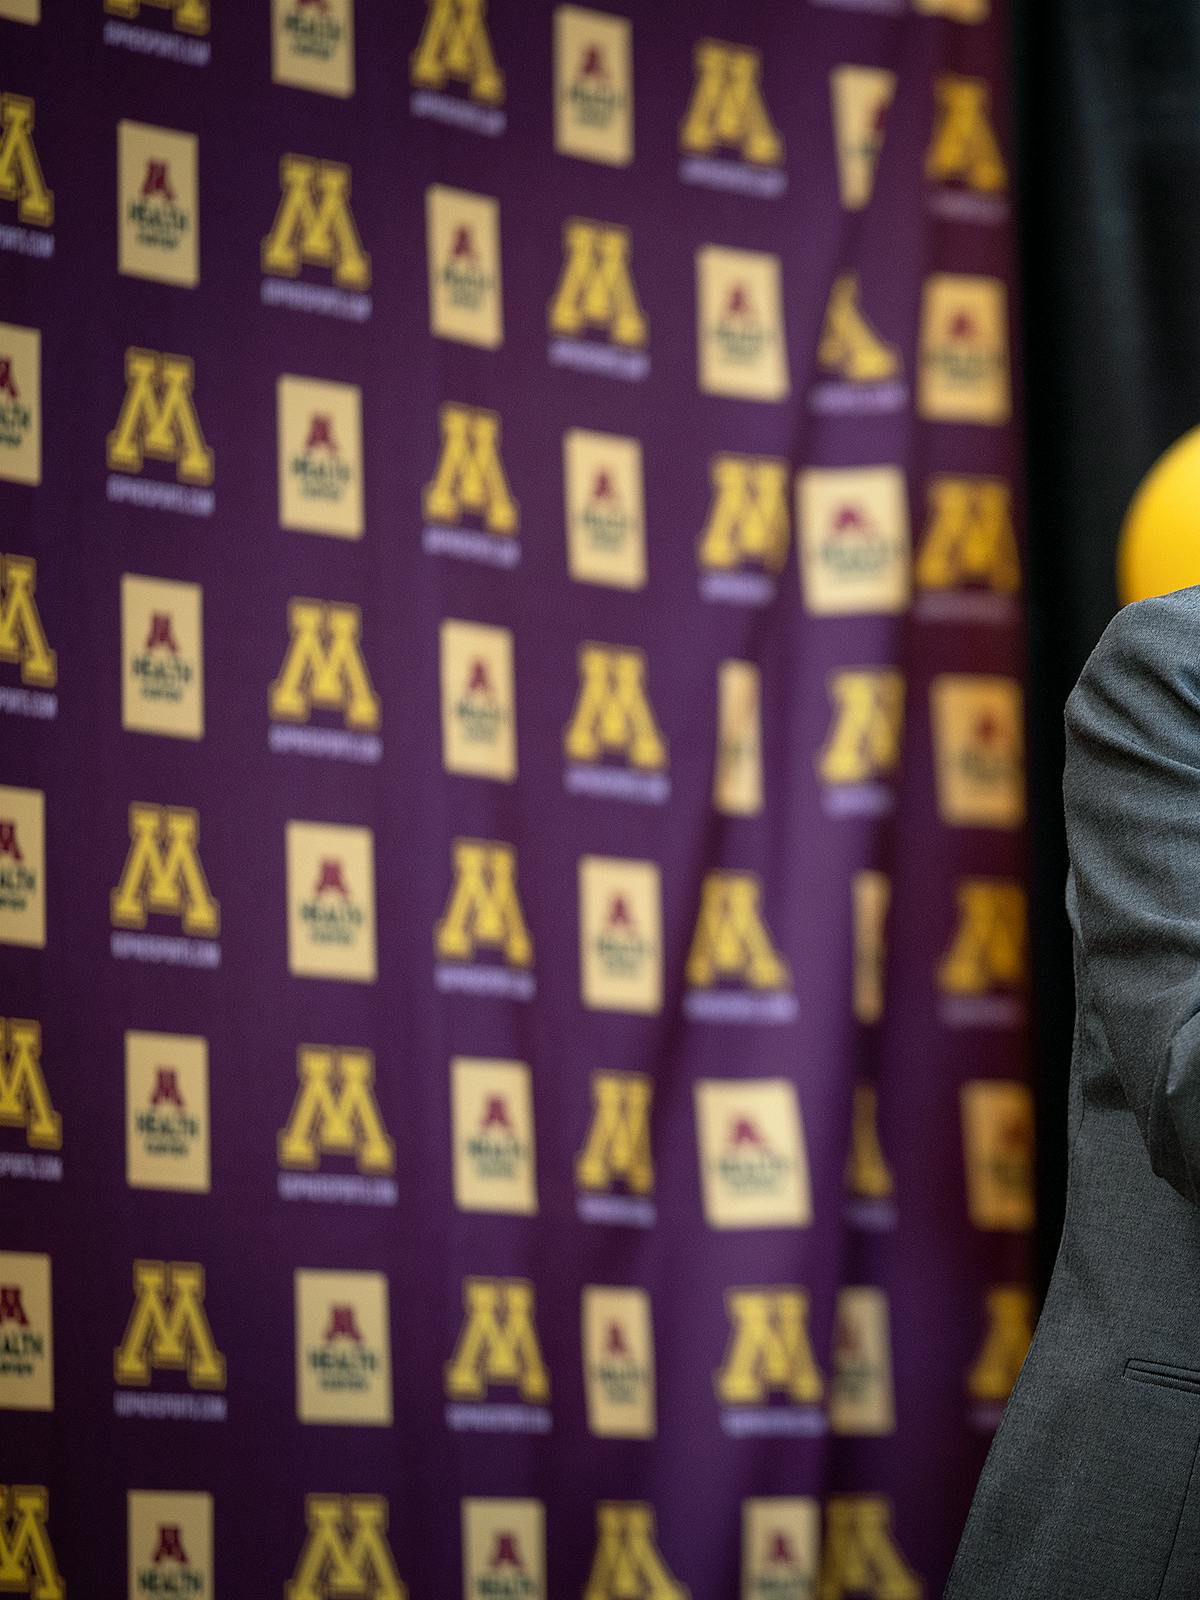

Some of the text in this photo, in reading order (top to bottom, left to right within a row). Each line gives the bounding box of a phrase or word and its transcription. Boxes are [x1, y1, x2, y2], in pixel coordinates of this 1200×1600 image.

[262, 155, 370, 289] M
[548, 220, 647, 348] M
[106, 349, 214, 486] M
[424, 404, 519, 535] M
[269, 601, 380, 731] M
[563, 645, 666, 771] M
[110, 802, 219, 936] M
[436, 841, 533, 969] M
[278, 1048, 395, 1173] M
[114, 1260, 226, 1390] M
[446, 1279, 550, 1402] M
